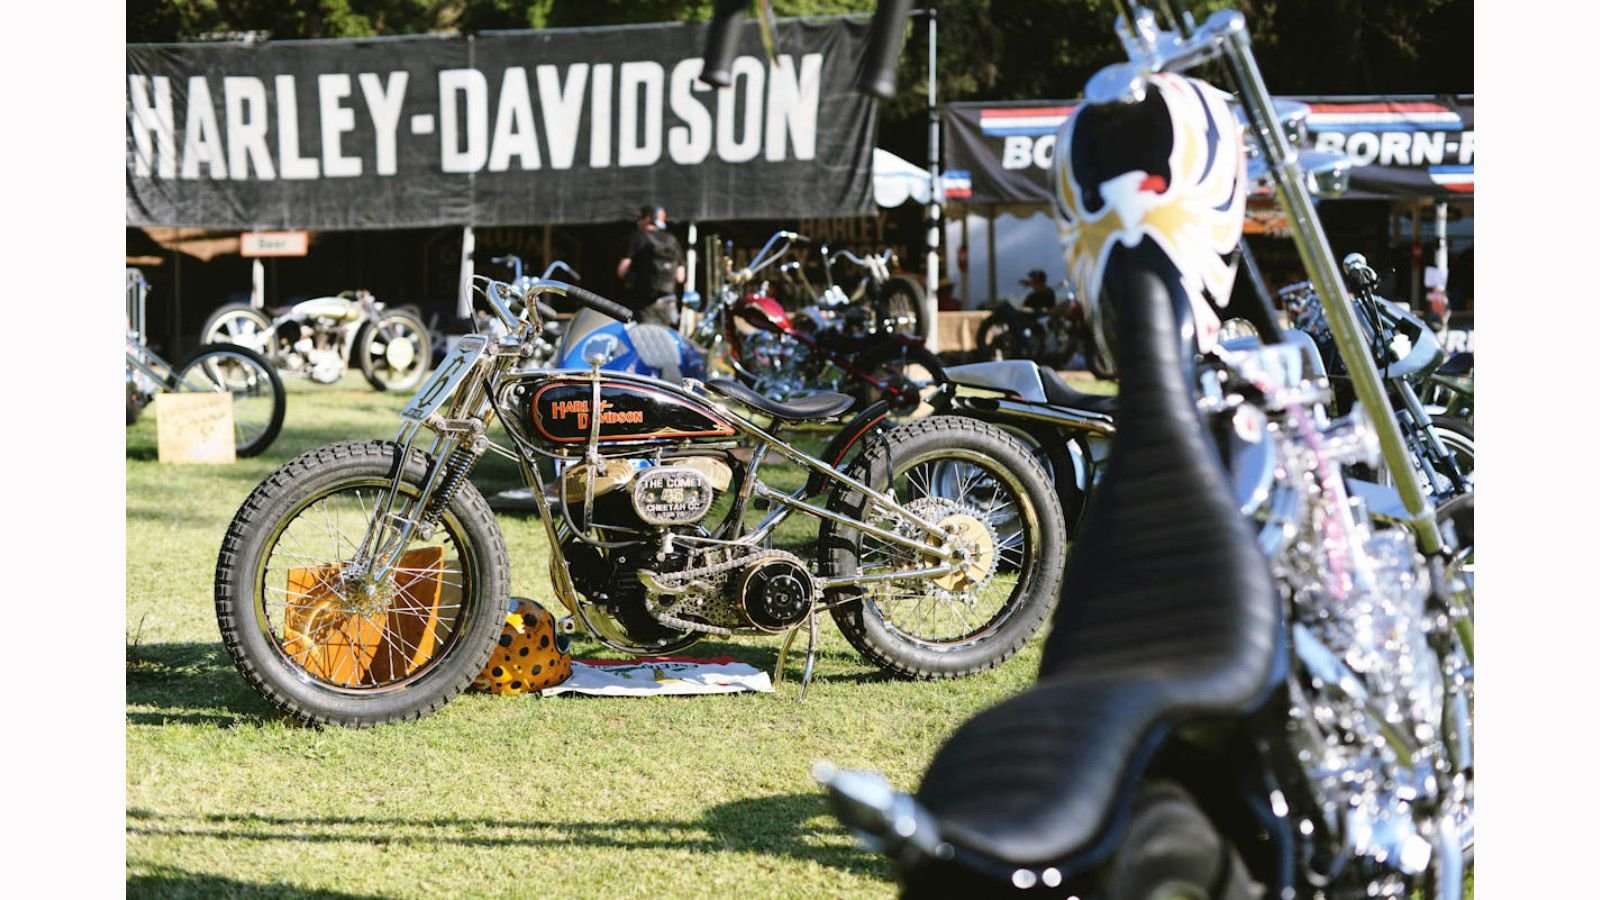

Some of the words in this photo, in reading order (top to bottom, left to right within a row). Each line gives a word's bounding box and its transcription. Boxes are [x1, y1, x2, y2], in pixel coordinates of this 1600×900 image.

[128, 52, 824, 182] HARLEY-DAVIDSON
[552, 400, 614, 419] HARLY-
[577, 411, 643, 429] DVIDSON
[644, 479, 664, 489] THE
[667, 478, 702, 488] COMET
[646, 502, 687, 512] CHEETAH
